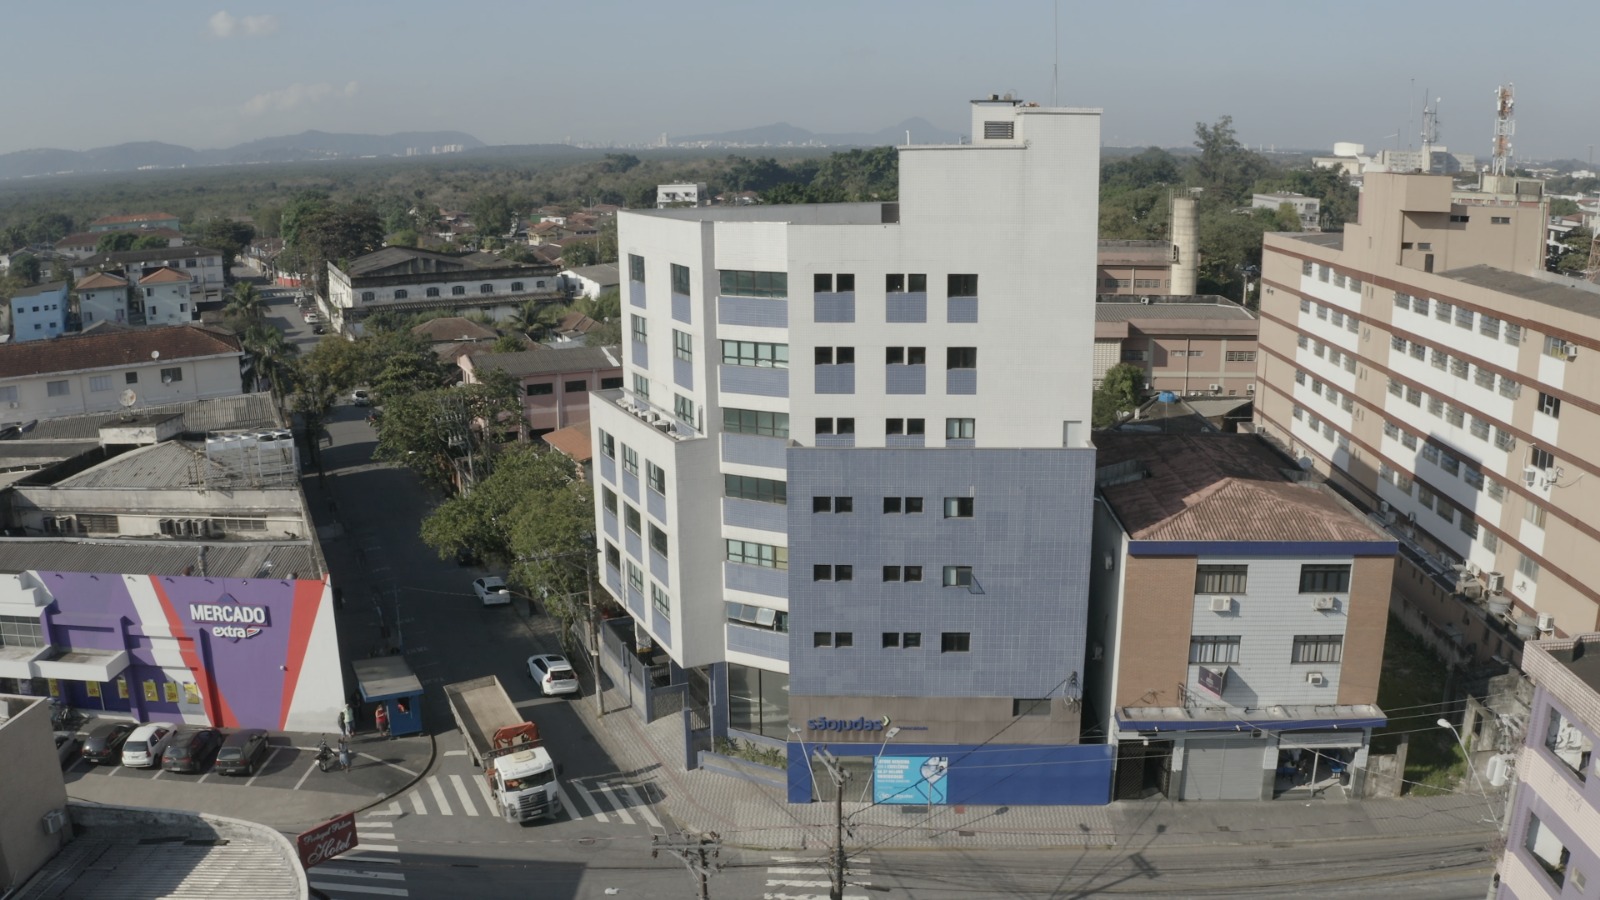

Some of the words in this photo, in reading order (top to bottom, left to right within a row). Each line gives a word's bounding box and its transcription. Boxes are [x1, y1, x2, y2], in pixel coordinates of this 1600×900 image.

[189, 604, 266, 624] MERCADO
[212, 625, 246, 638] extra
[807, 716, 883, 732] sãojudas
[307, 831, 353, 865] Hotel
